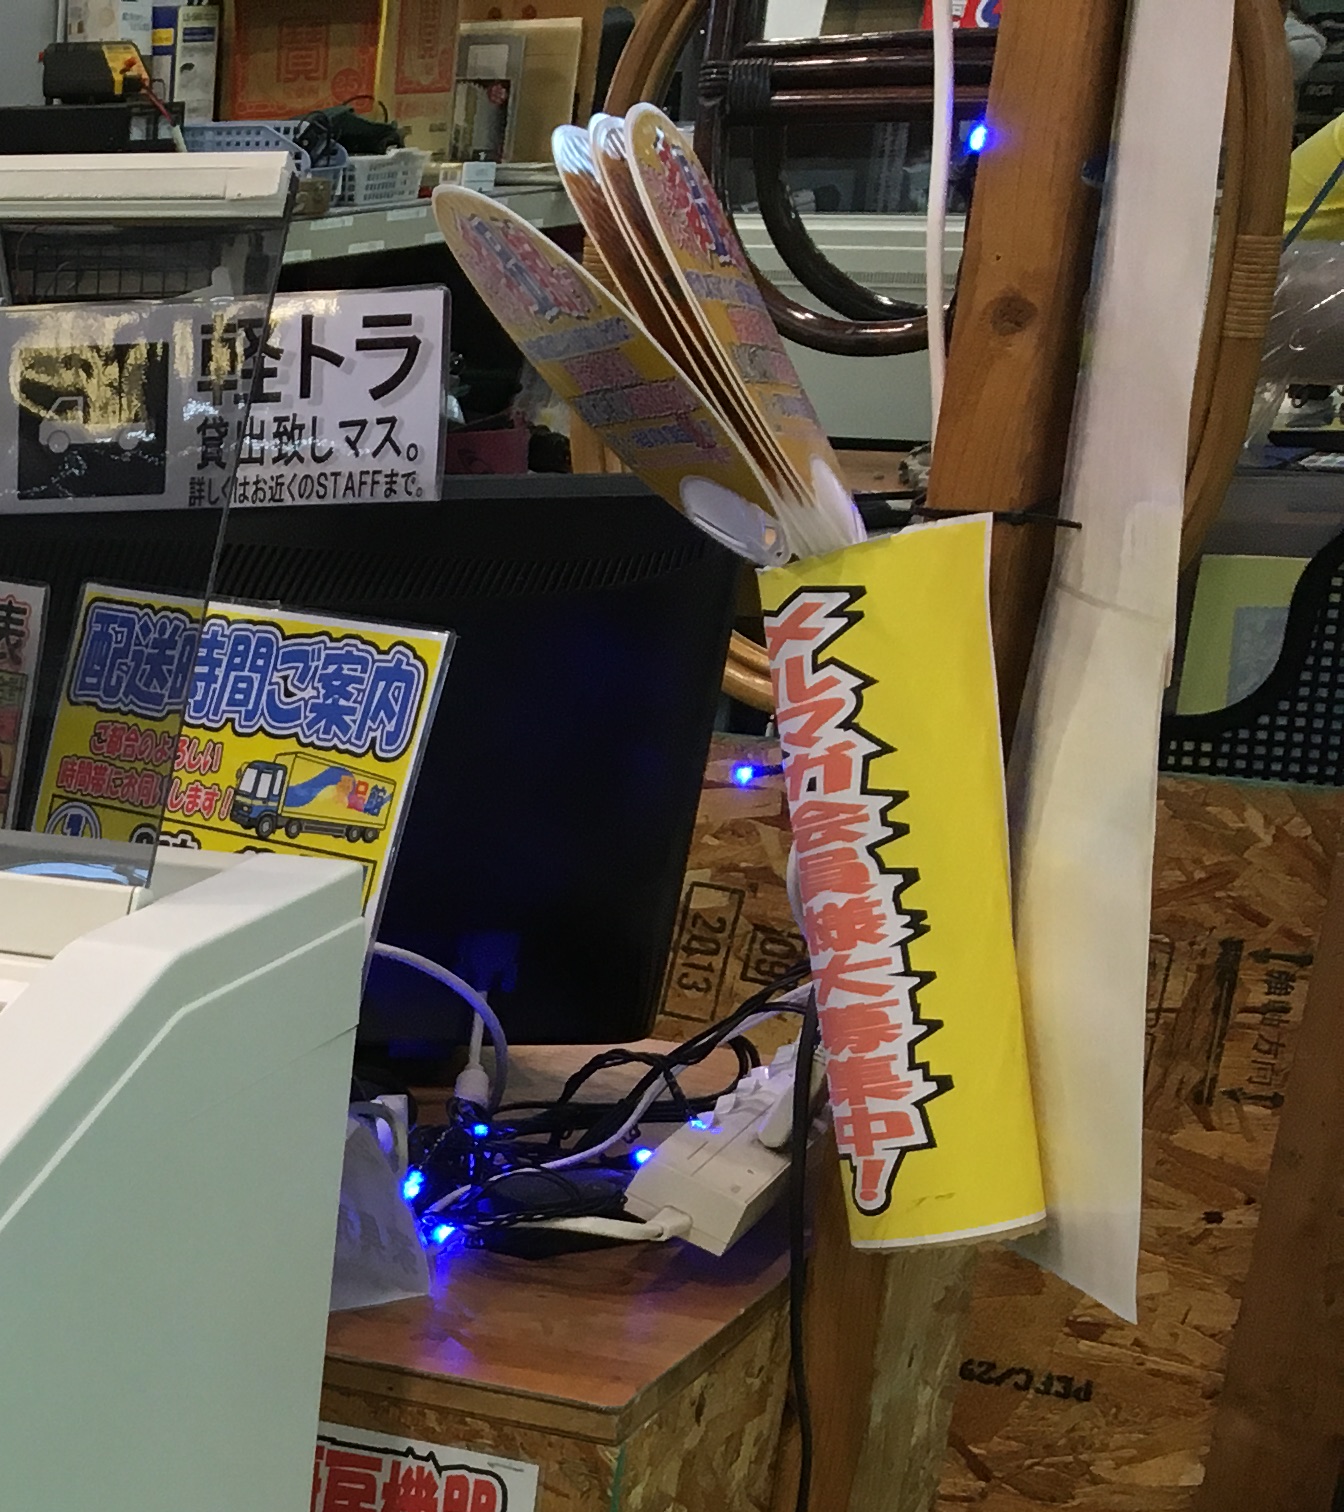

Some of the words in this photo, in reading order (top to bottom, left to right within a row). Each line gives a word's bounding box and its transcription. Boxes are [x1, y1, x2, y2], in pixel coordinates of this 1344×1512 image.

[197, 313, 422, 405] 軽トラ
[196, 413, 419, 470] 貸出致しマス。
[189, 469, 423, 507] 詳しくはお近くのSTAFFまで。
[74, 606, 421, 750] 配送時間ご案内
[90, 722, 222, 773] ご都合のよろしい
[766, 600, 916, 1201] メルマガ会員様大募集中!
[677, 911, 727, 993] 2013
